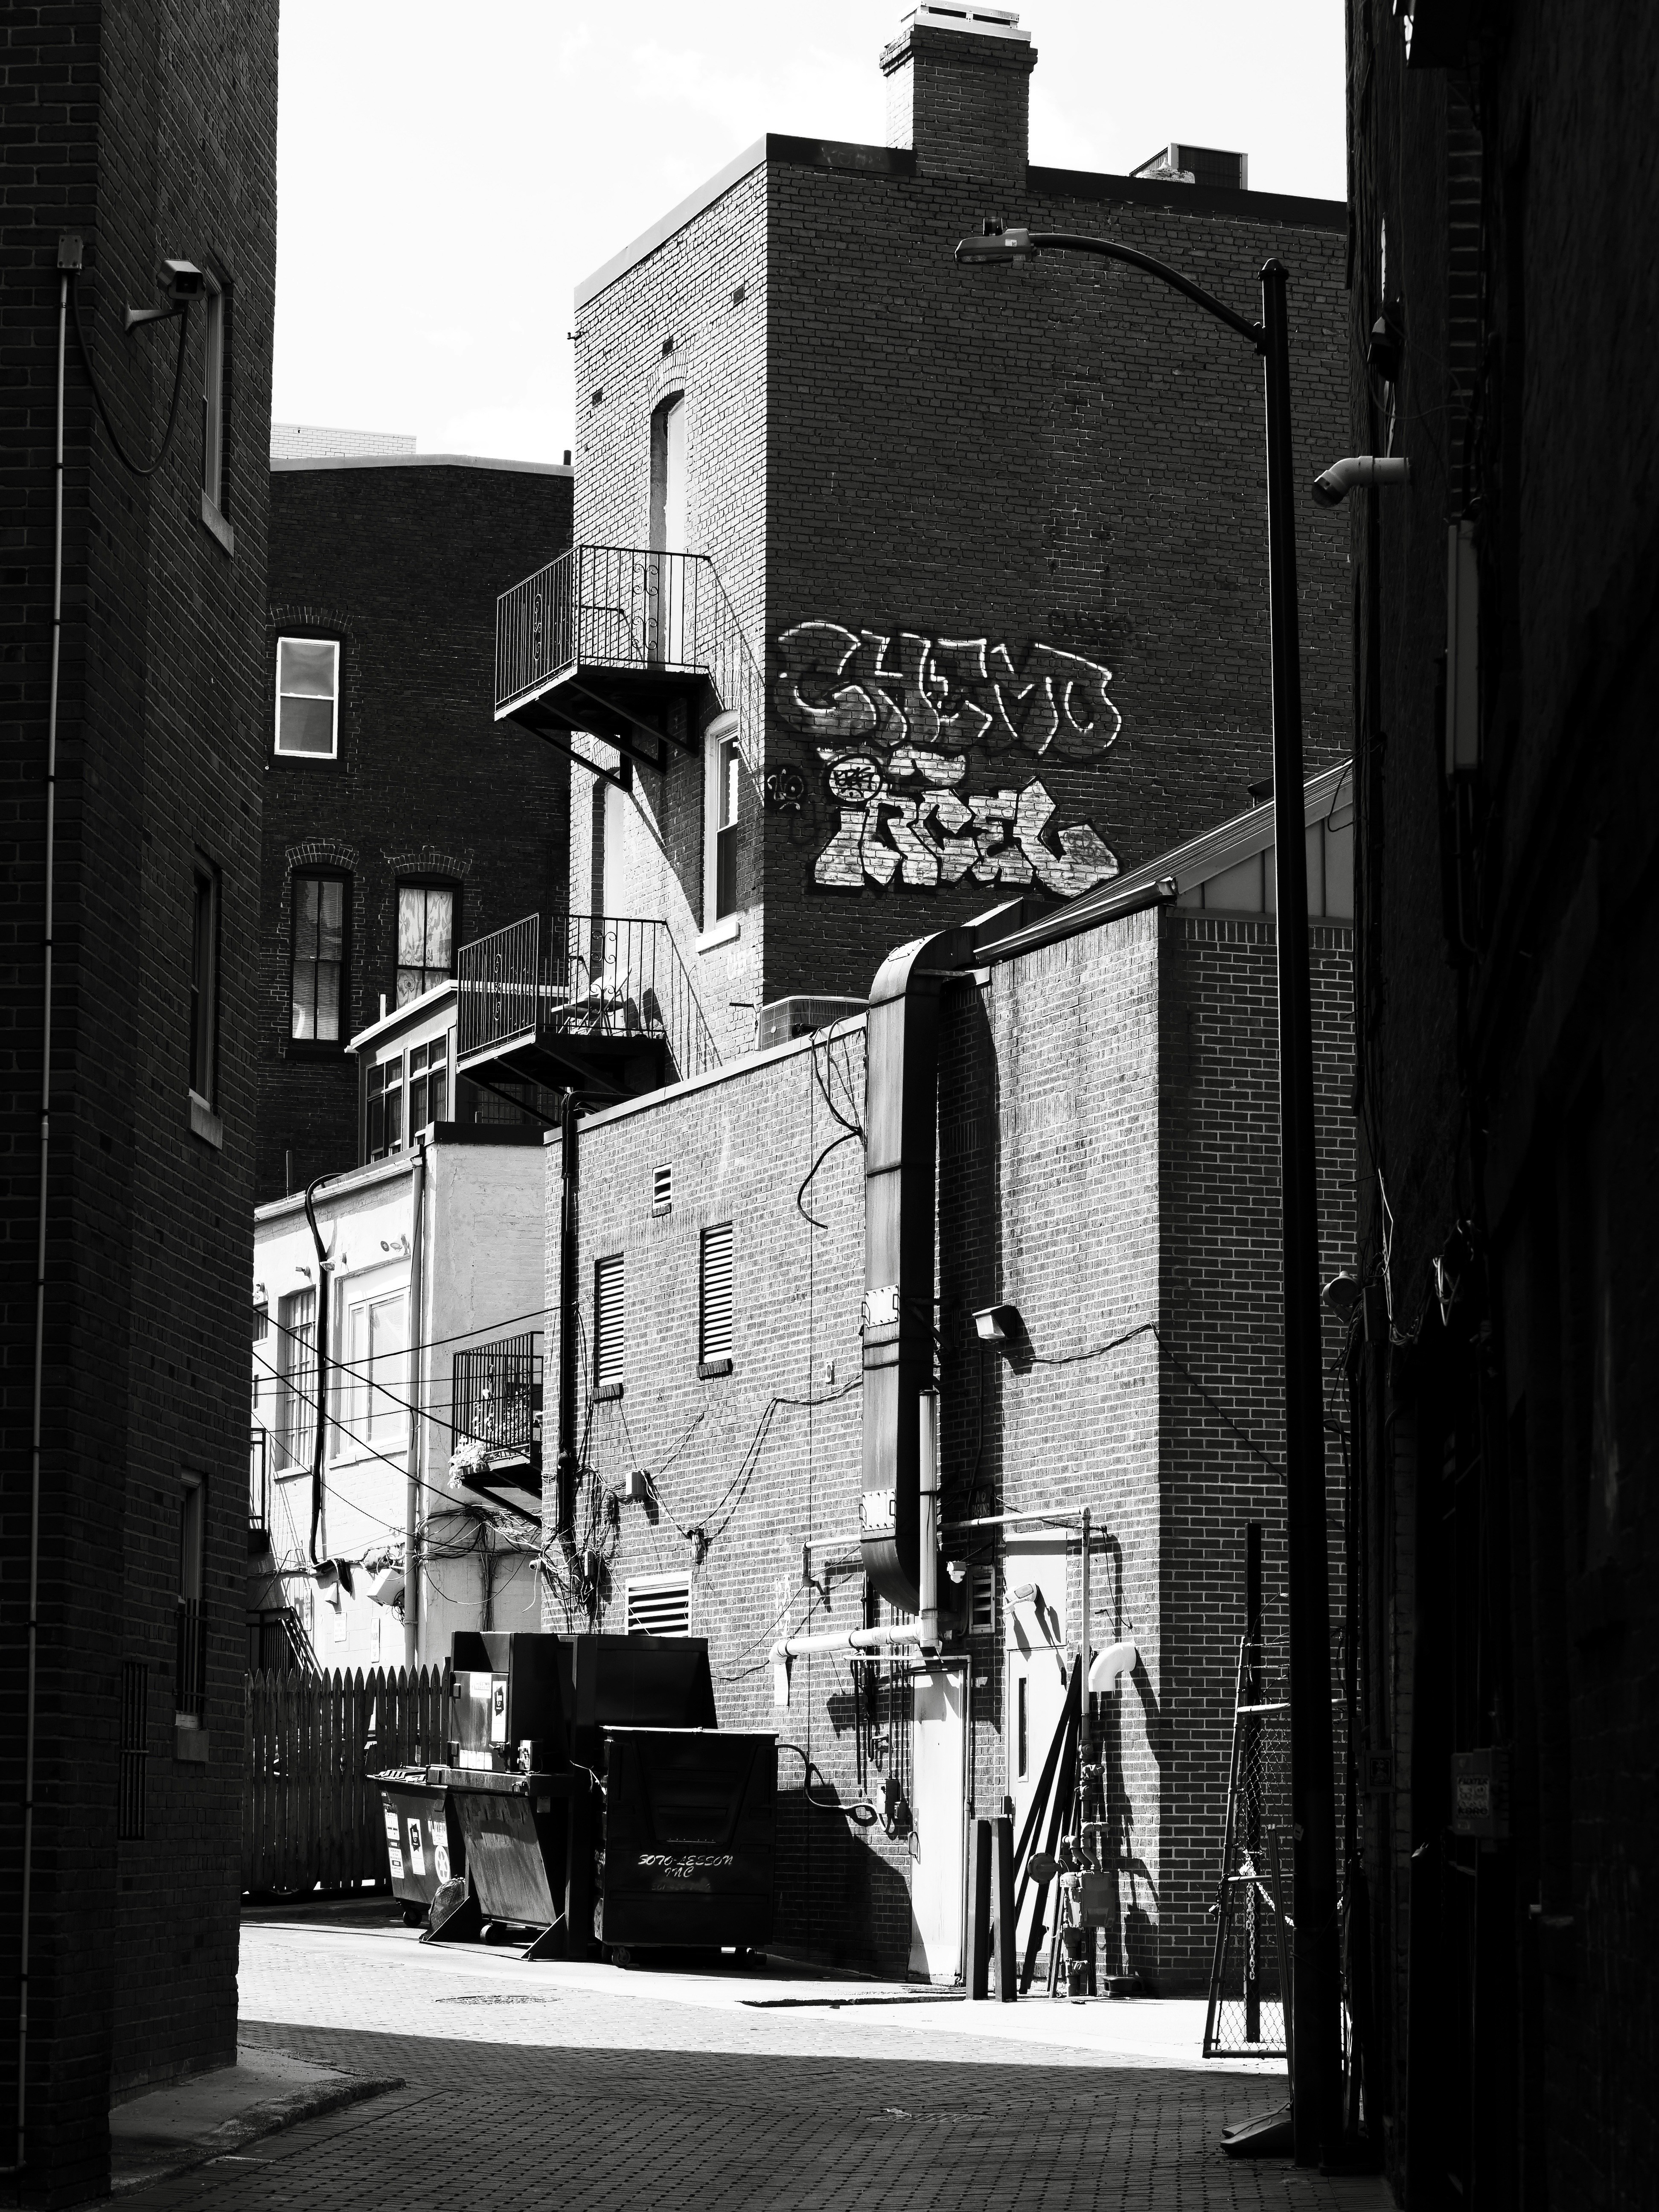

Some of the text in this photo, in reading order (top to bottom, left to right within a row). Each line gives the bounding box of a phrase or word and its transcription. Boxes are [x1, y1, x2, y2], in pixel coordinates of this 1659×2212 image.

[975, 1490, 986, 1503] NO
[972, 1503, 990, 1518] PARKING
[638, 1854, 733, 1866] SOTO-LEESON
[665, 1866, 694, 1877] INC
